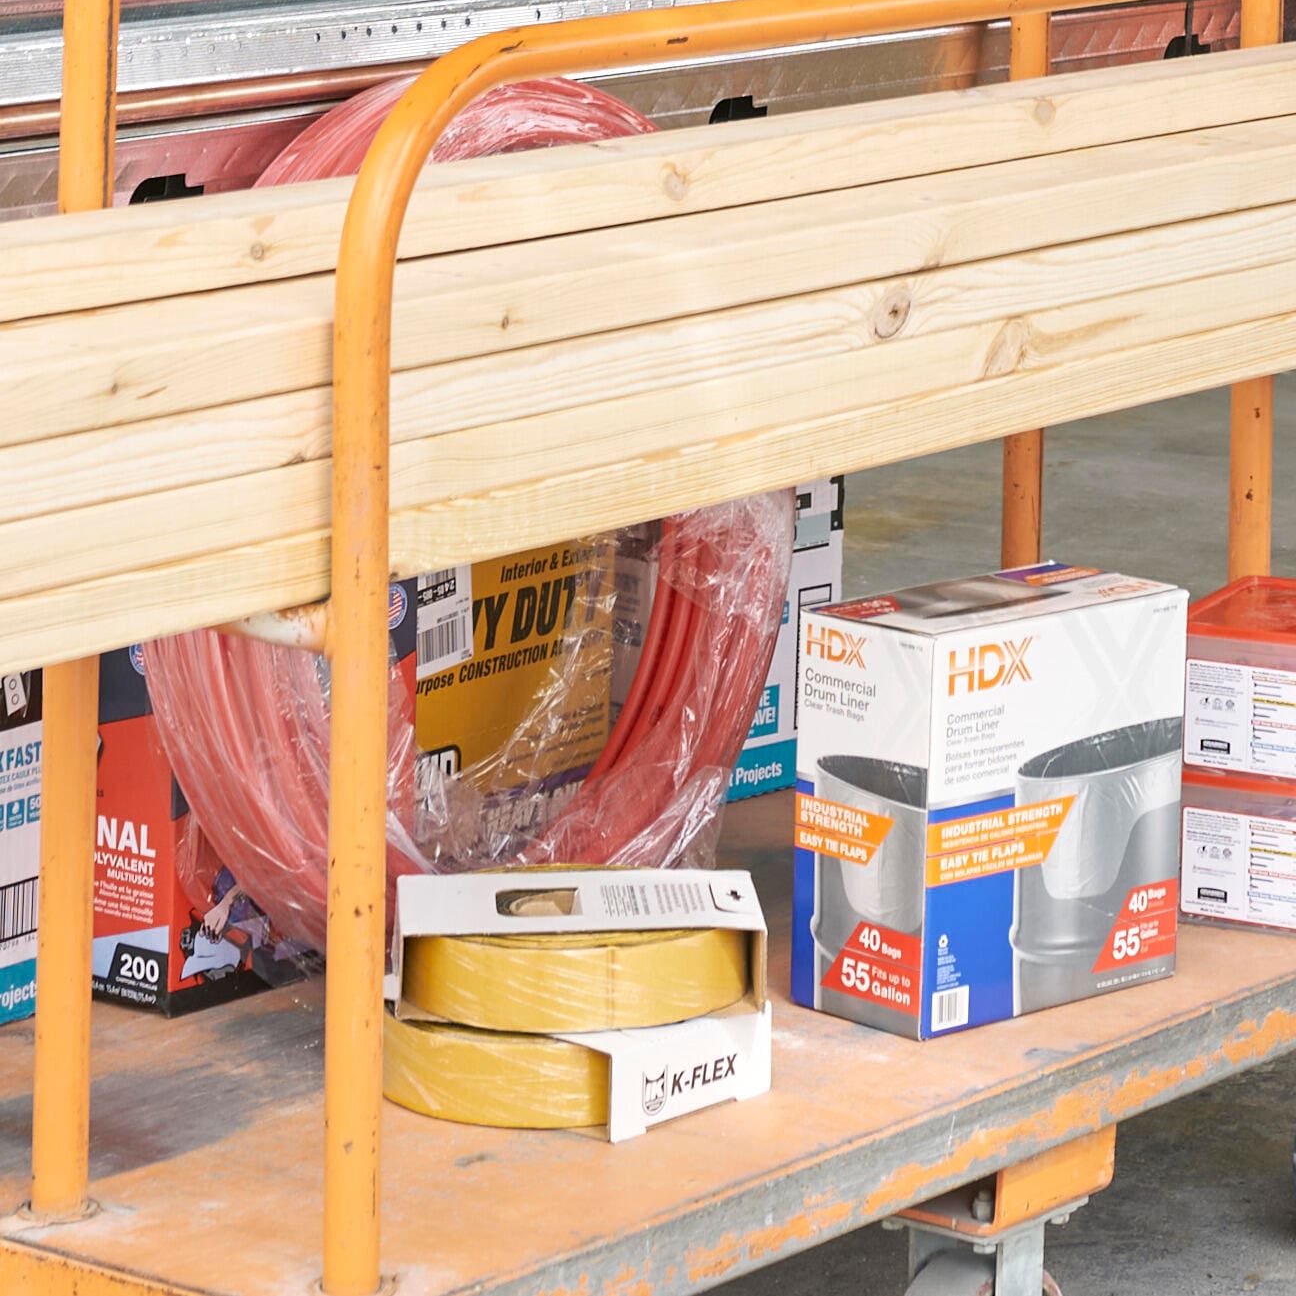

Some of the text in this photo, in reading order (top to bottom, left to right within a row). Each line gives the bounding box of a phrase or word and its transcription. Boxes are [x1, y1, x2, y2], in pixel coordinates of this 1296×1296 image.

[500, 556, 548, 584] Interior
[549, 552, 559, 570] &
[806, 623, 867, 670] HDX
[416, 673, 454, 697] urpose
[458, 643, 548, 684] CONSTRUCTION
[947, 636, 1033, 697] HDX
[805, 667, 877, 697] Commercial
[804, 683, 870, 712] Drum Liner
[753, 707, 776, 726] AVE!
[946, 703, 1005, 725] Commercial
[946, 719, 999, 739] Drum Liner
[6, 741, 42, 771] FAST
[735, 762, 783, 786] Projects
[801, 798, 869, 828] INDUSTRIAL
[801, 810, 862, 837] STRENGTH
[941, 803, 1063, 840] INDUSTRIAL STRENGTH
[97, 815, 156, 858] NAL
[800, 831, 868, 862] EASY TIE FLAPS
[940, 842, 1025, 871] EASY TIE FLAPS
[106, 868, 154, 887] MULTIUSOS
[1128, 890, 1148, 913] 40
[859, 926, 902, 960] 40 Bags
[1112, 926, 1140, 960] 55
[120, 952, 160, 984] 200
[840, 957, 911, 1006] 55 Gallon
[871, 966, 911, 988] Fits up to
[670, 1052, 738, 1097] K-FLEX
